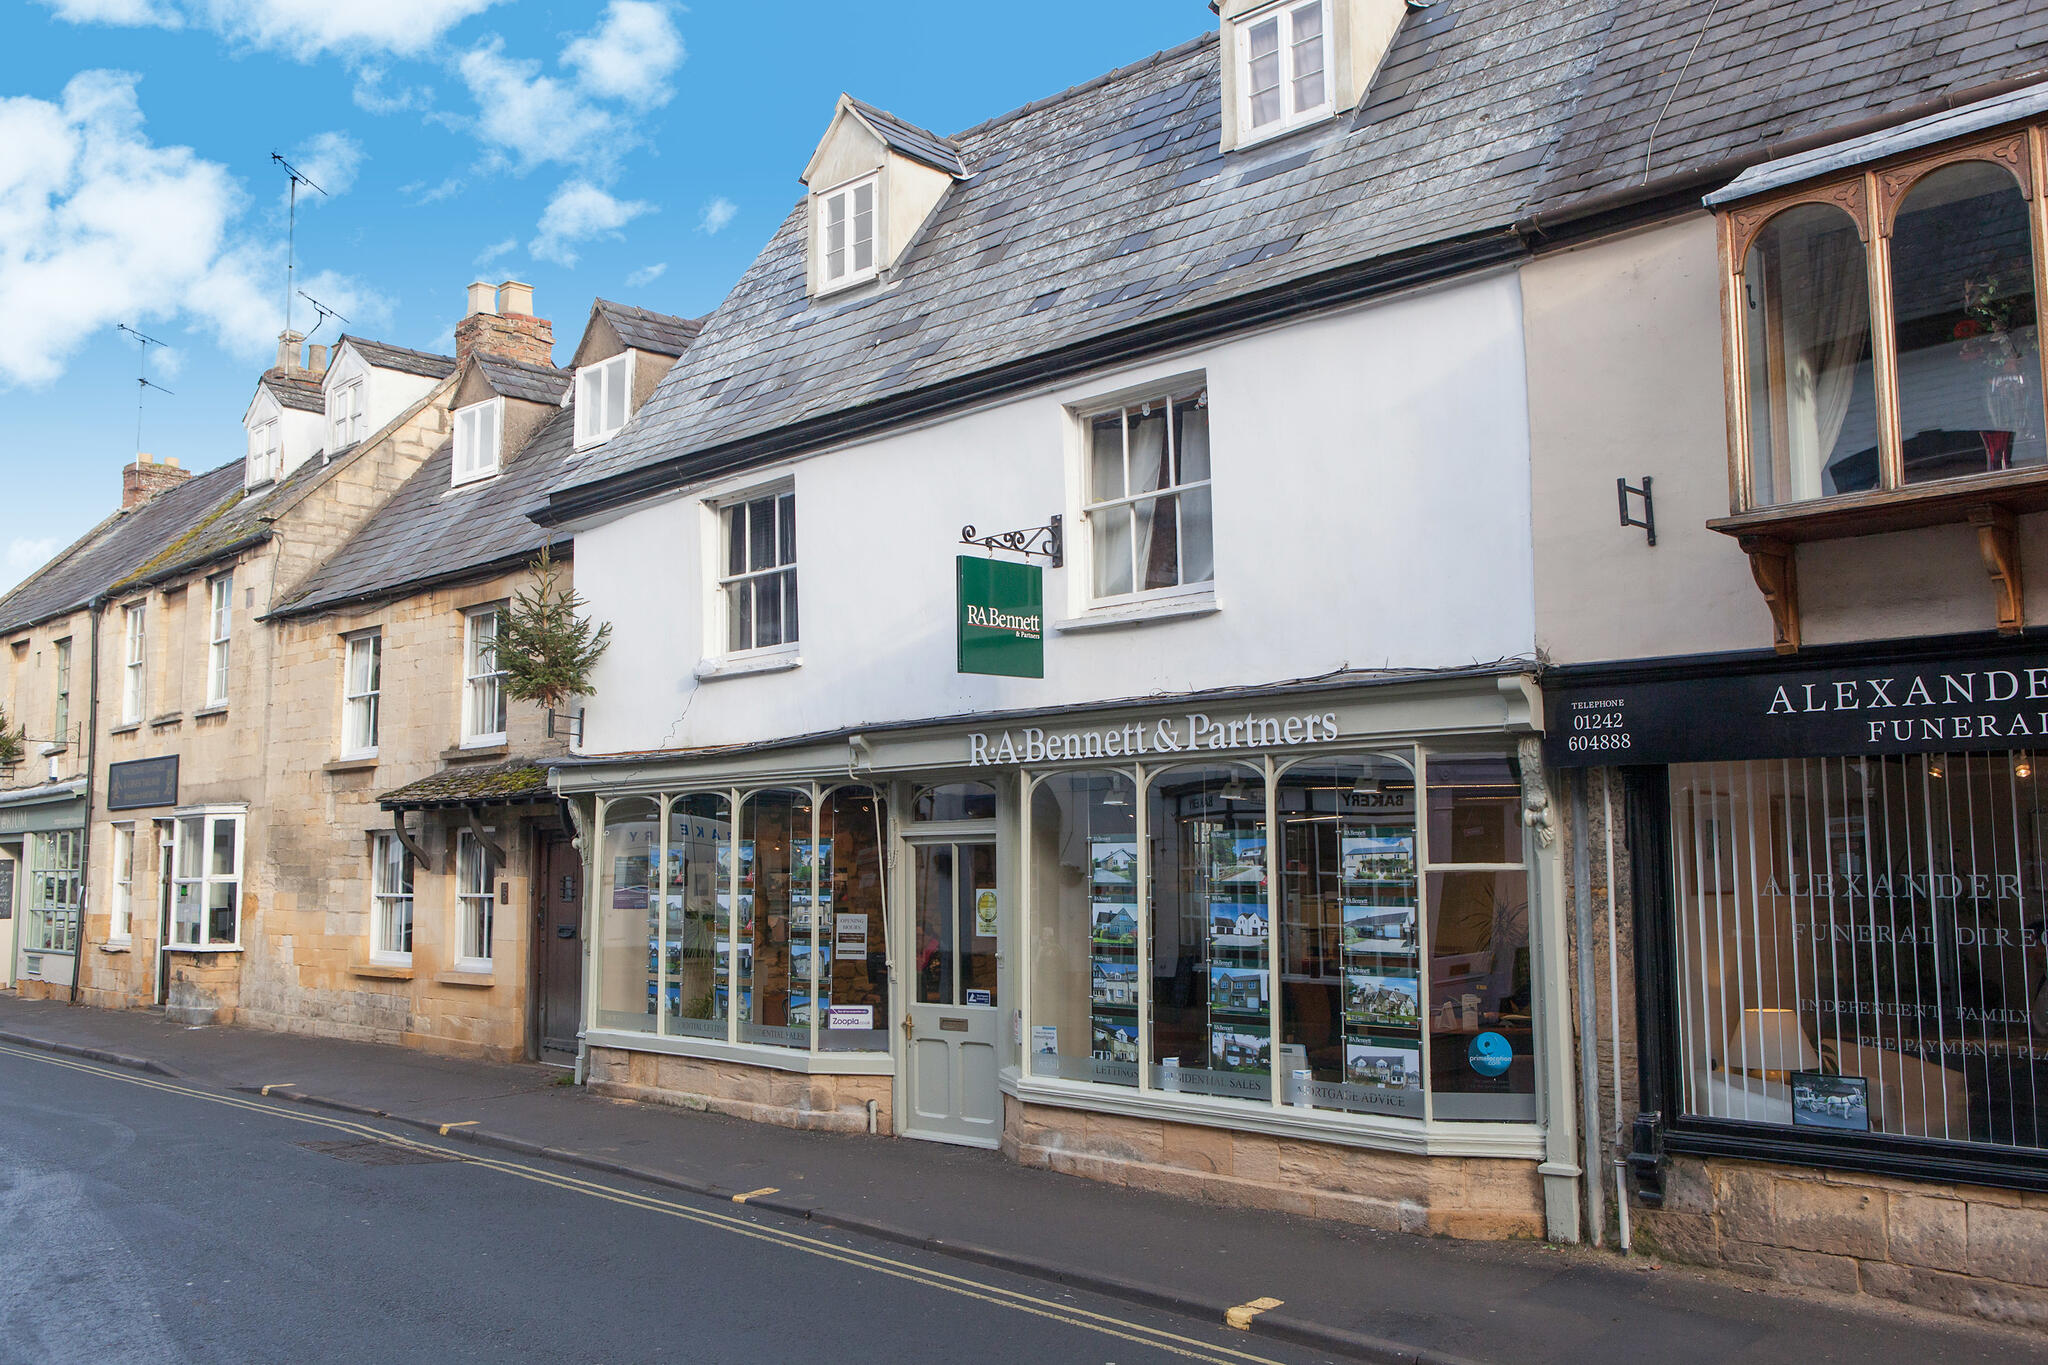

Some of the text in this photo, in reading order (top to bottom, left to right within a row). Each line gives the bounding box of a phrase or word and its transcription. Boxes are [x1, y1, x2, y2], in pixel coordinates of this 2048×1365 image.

[1571, 699, 1625, 710] TELEPHONE
[1573, 712, 1624, 730] 01242
[1153, 718, 1182, 753] &
[1185, 712, 1338, 751] Partners
[1568, 733, 1631, 751] 604888
[1760, 873, 2026, 900] ALEXANDER
[1794, 923, 1936, 944] FUNERAL
[1801, 998, 2031, 1024] INDEPENDENT FAMILY
[1229, 1079, 1262, 1091] SALES
[1360, 1093, 1406, 1107] ADVICE
